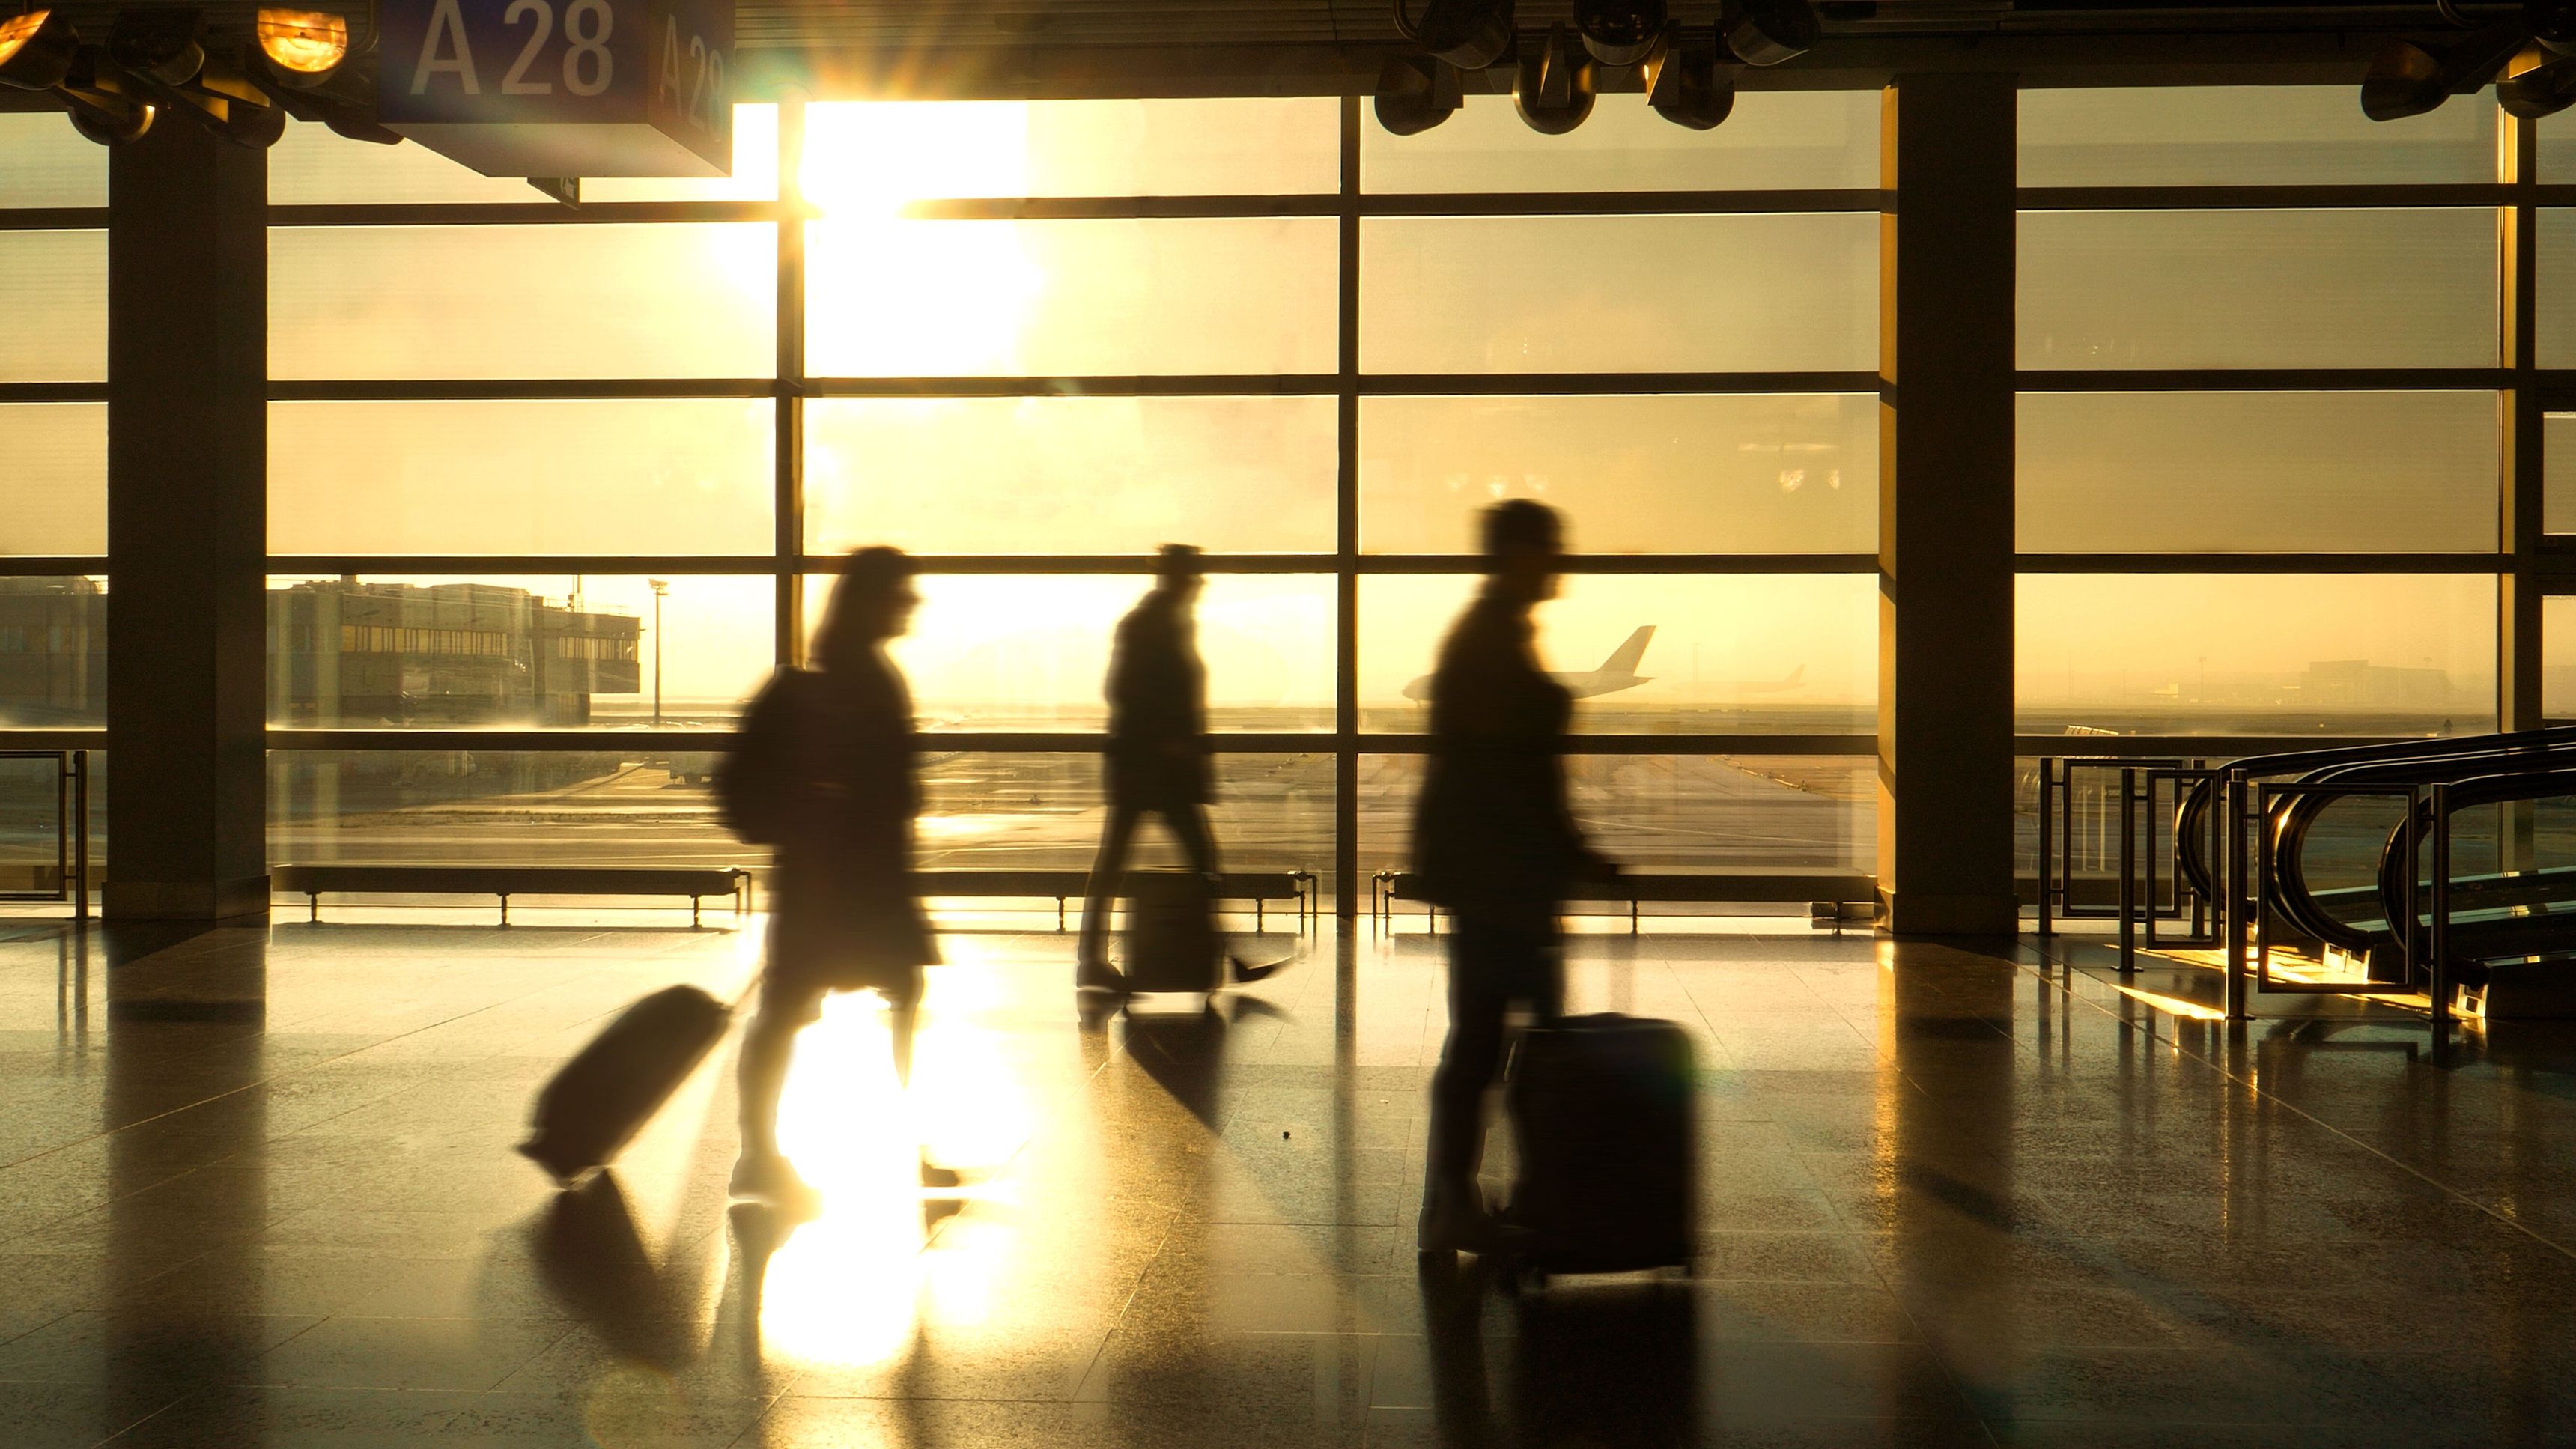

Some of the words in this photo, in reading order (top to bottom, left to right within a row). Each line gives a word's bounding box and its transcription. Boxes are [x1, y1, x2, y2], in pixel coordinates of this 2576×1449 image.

[410, 0, 481, 95] A
[502, 0, 613, 97] 28
[659, 13, 682, 117] A
[689, 34, 723, 142] 28
